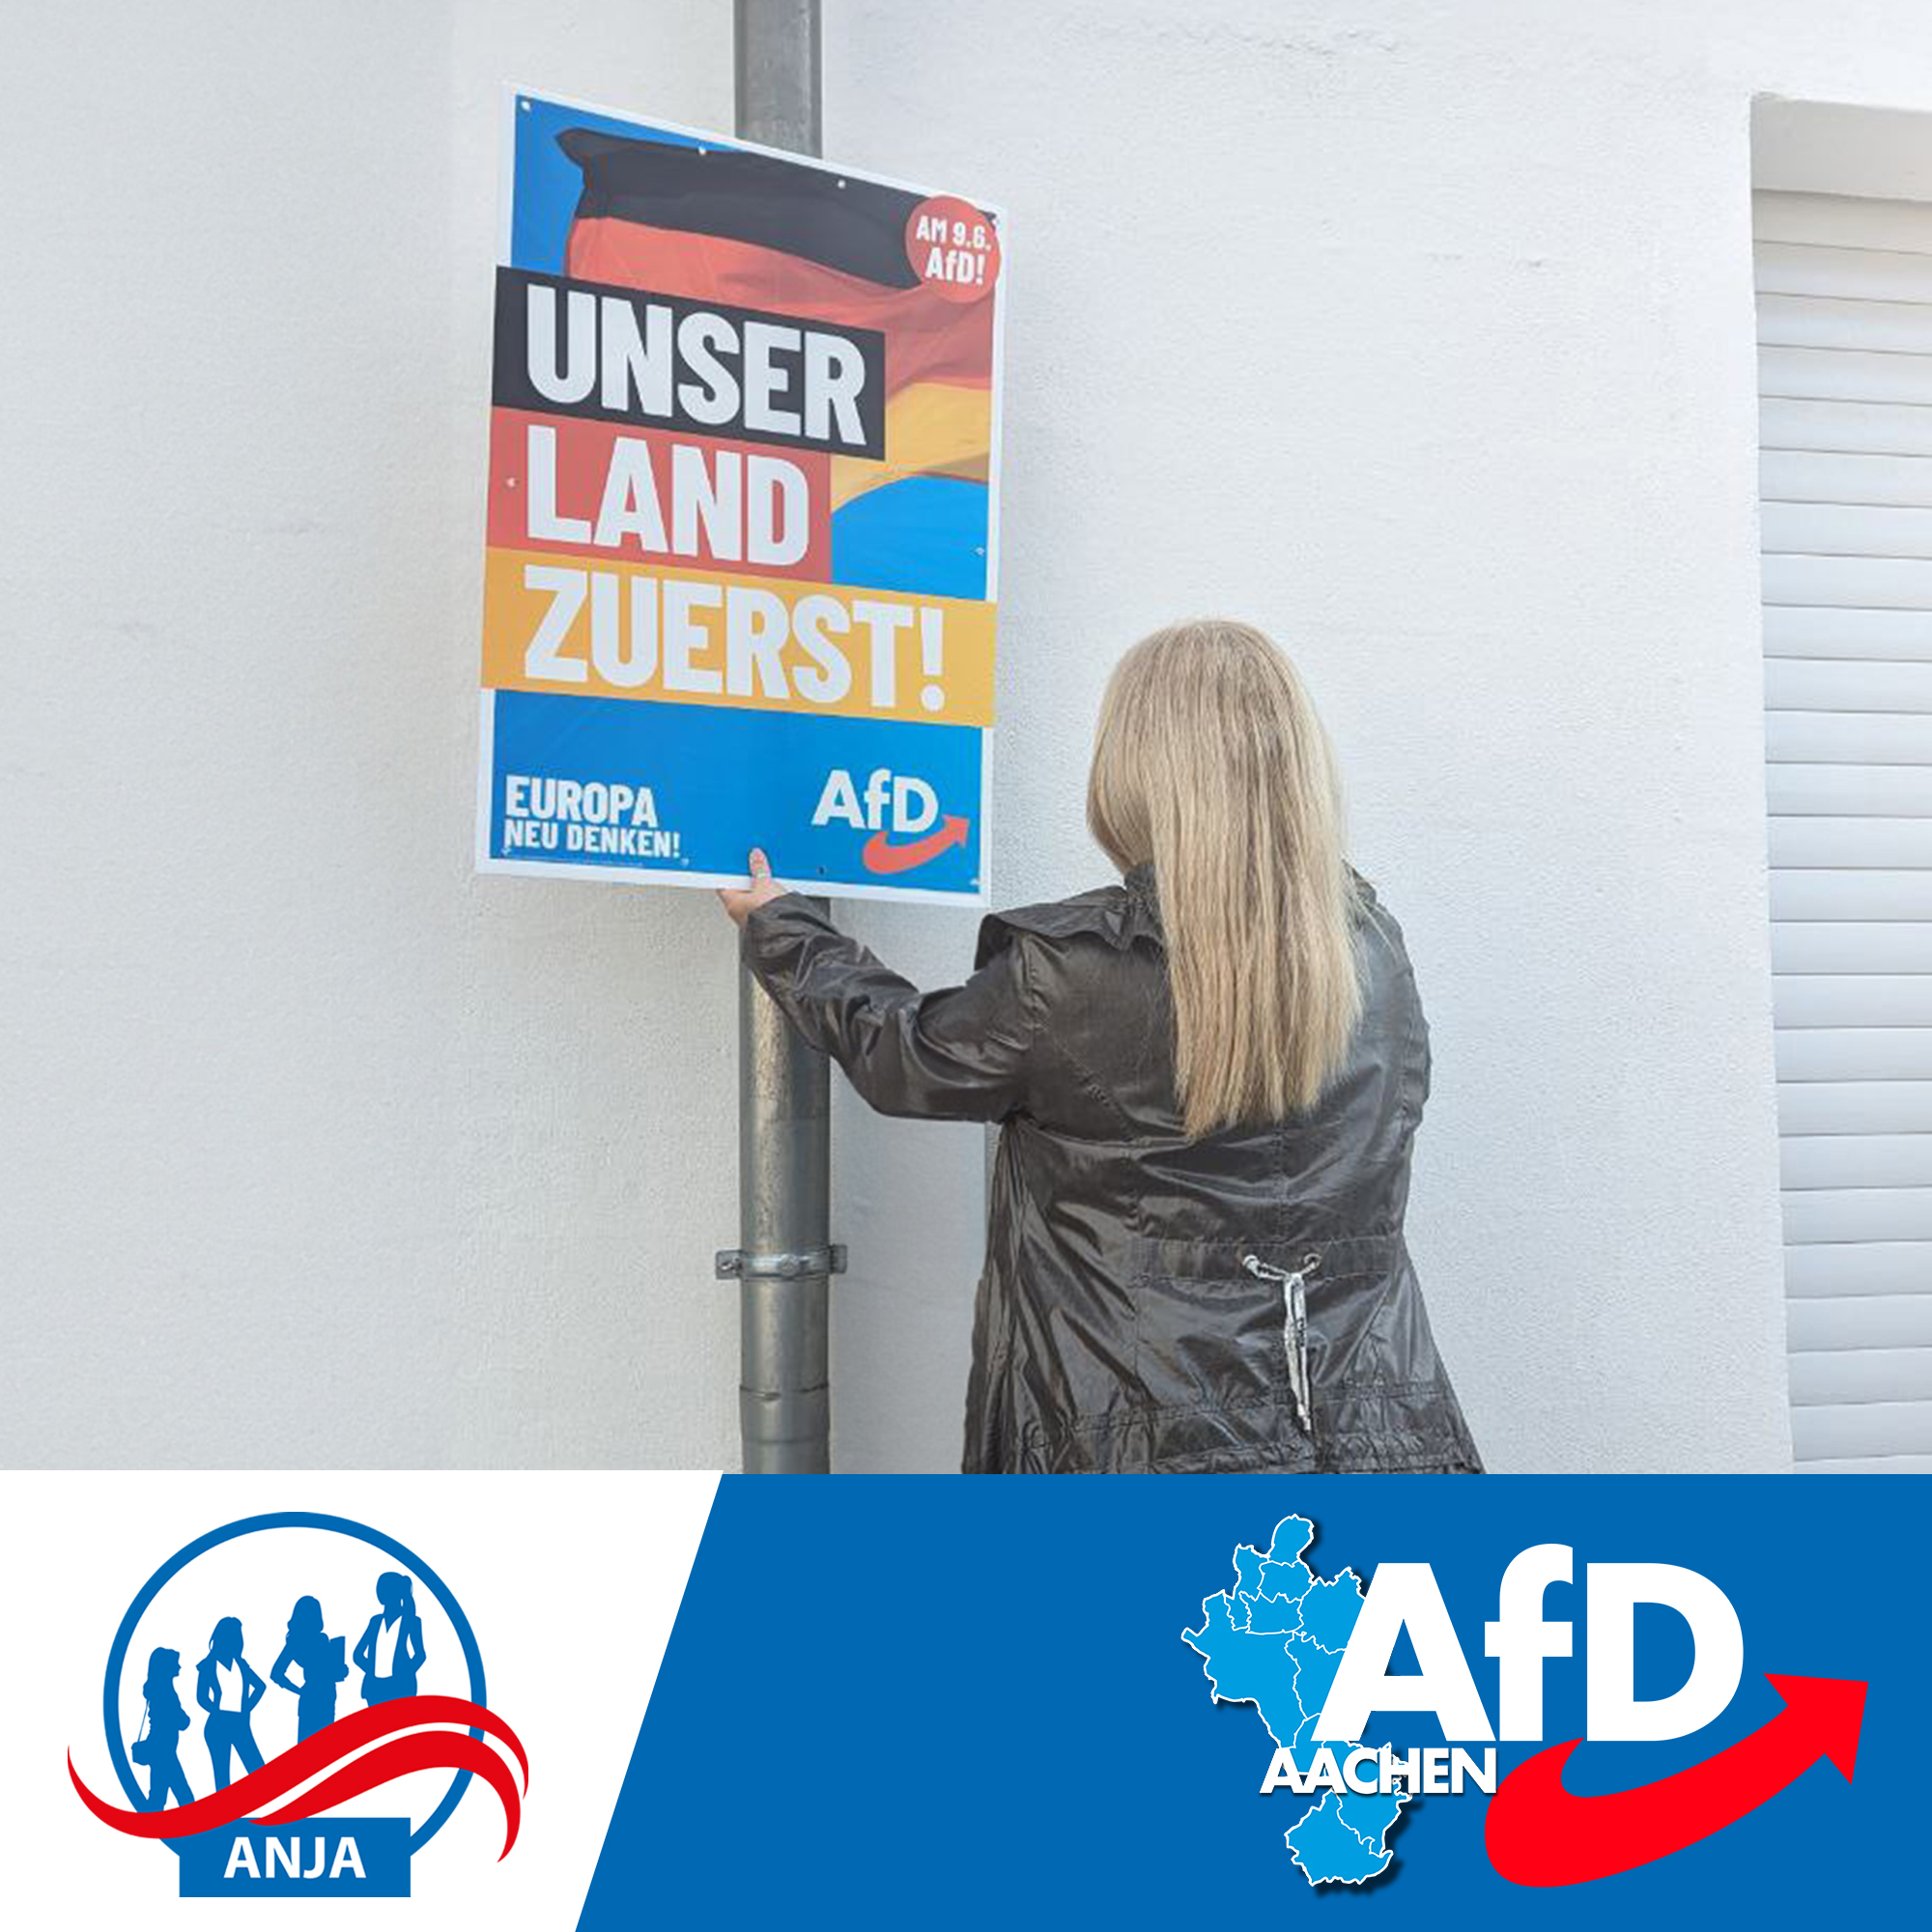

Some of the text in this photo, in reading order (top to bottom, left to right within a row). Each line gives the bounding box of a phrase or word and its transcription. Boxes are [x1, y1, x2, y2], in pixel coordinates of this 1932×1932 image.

[916, 214, 992, 251] AM 9.6.
[924, 246, 985, 285] AfD!
[526, 283, 867, 445] UNSER
[526, 424, 810, 567] LAND
[524, 564, 946, 712] ZUERST!
[505, 775, 659, 828] EUROPA
[810, 768, 939, 834] AfD
[503, 819, 681, 858] NEU DENKEN!
